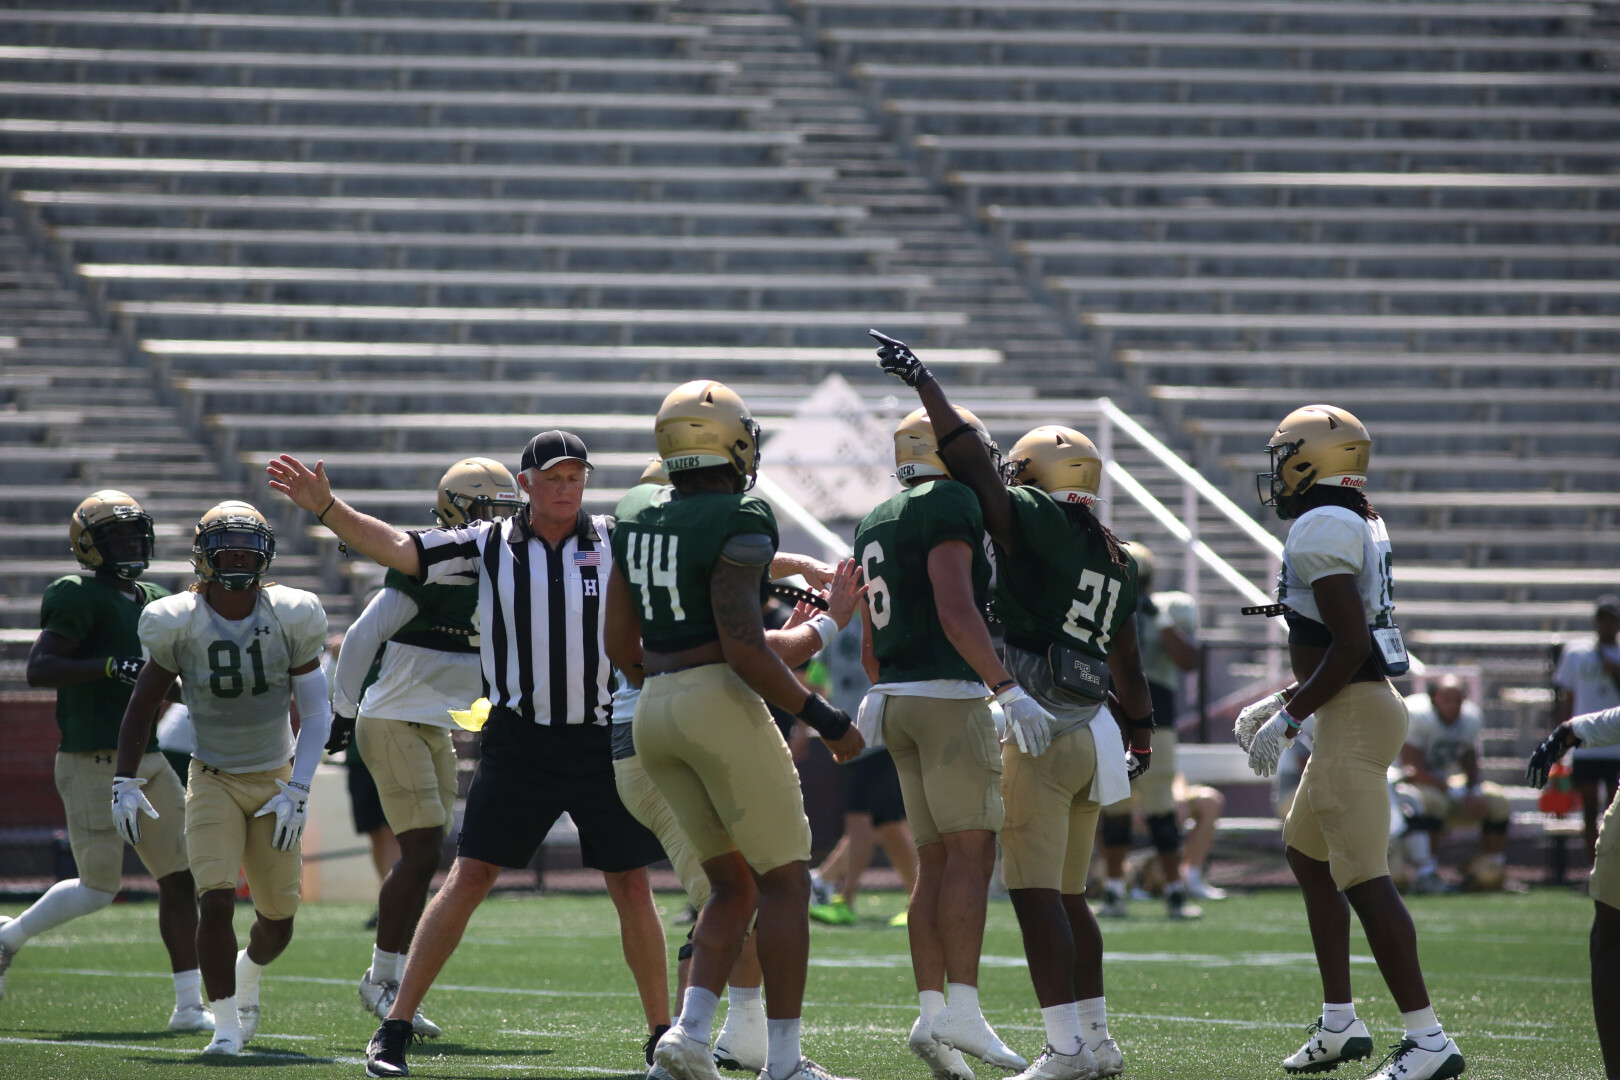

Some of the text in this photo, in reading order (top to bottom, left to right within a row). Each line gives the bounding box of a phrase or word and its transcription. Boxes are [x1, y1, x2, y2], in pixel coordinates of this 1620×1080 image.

[666, 456, 700, 471] BLAZERS
[583, 579, 598, 596] H
[626, 532, 686, 621] 44
[862, 540, 891, 630] 6
[1062, 568, 1121, 654] 21
[207, 639, 270, 698] 81
